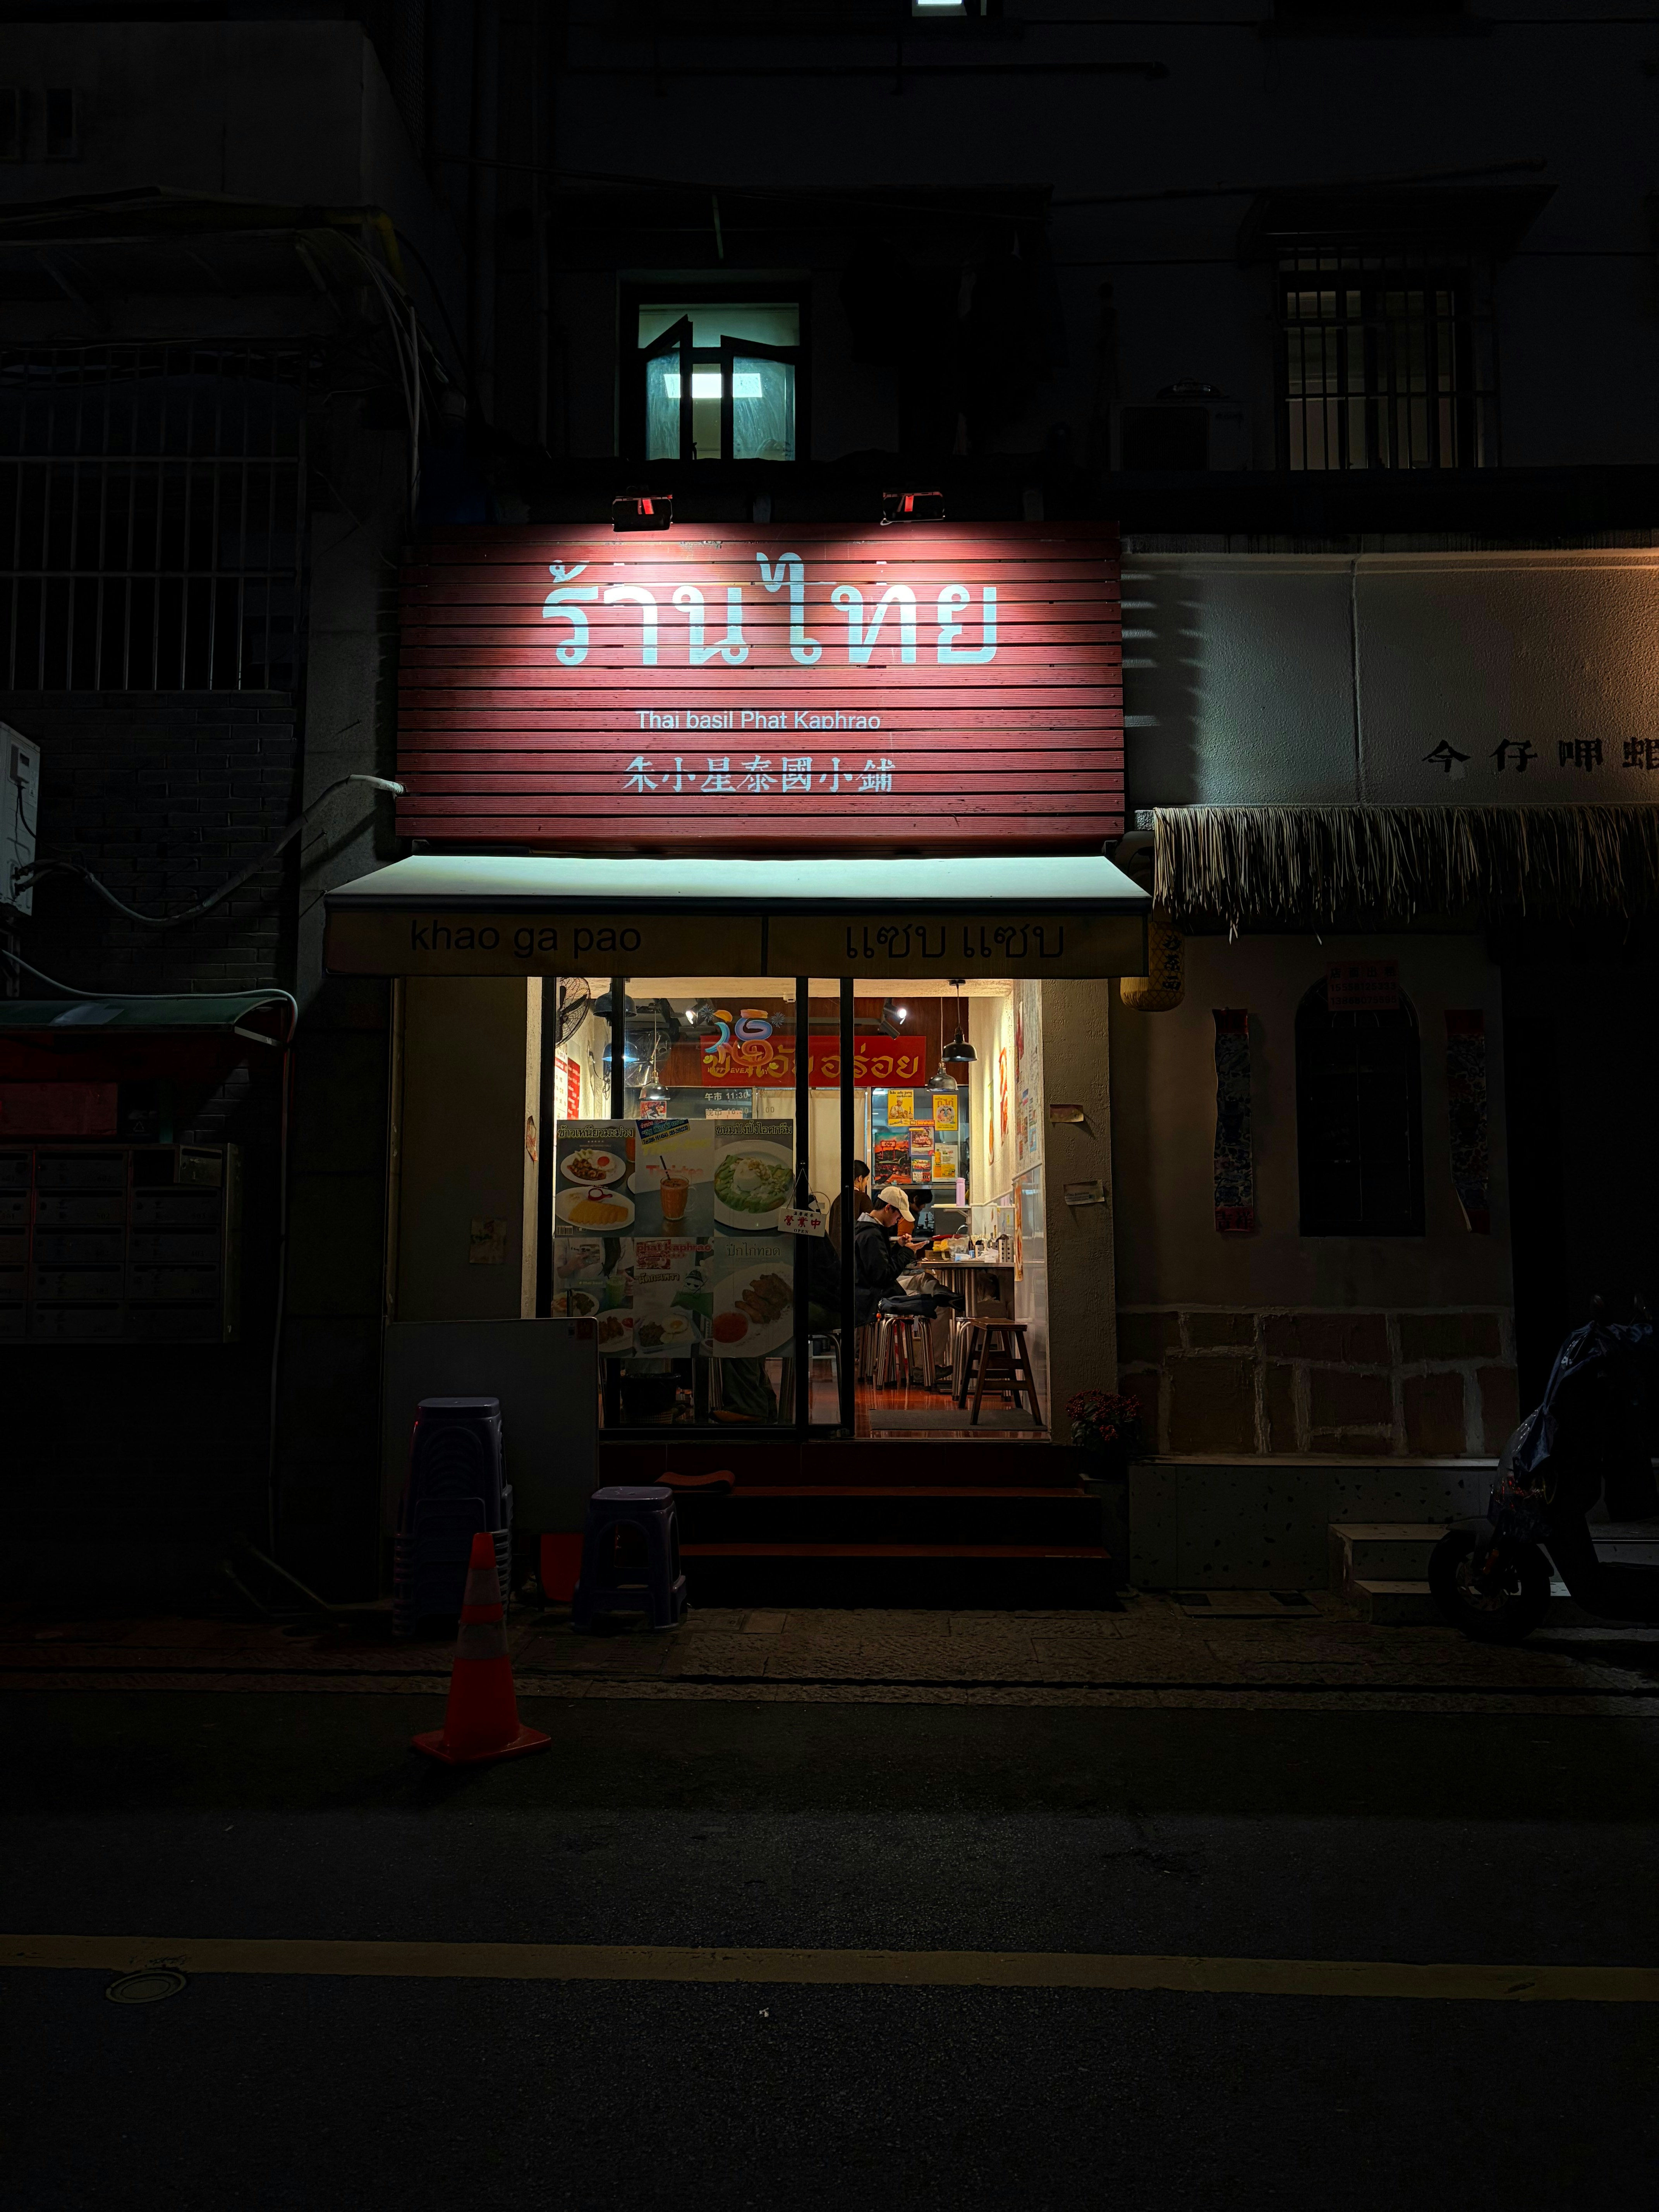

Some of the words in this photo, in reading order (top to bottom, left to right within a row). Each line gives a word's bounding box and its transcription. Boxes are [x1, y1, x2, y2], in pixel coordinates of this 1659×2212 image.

[543, 551, 998, 665] ร้านไทย
[635, 710, 679, 729] Thai
[686, 710, 733, 729] basil
[741, 710, 788, 729] Phat
[794, 710, 881, 729] Kaphrao
[411, 919, 500, 952] khao
[514, 926, 558, 959] ga
[574, 926, 641, 959] pao
[847, 923, 946, 958] แซบ
[963, 923, 1063, 958] แซบ
[704, 1092, 722, 1101] 午市
[558, 1125, 634, 1138] ข้าวเหนียวมะม่วง
[715, 1120, 793, 1135] ขนมปังปิ้งไอศกรีม
[784, 1215, 821, 1230] 營業中
[726, 1242, 780, 1256] ปีกไก่ทอด
